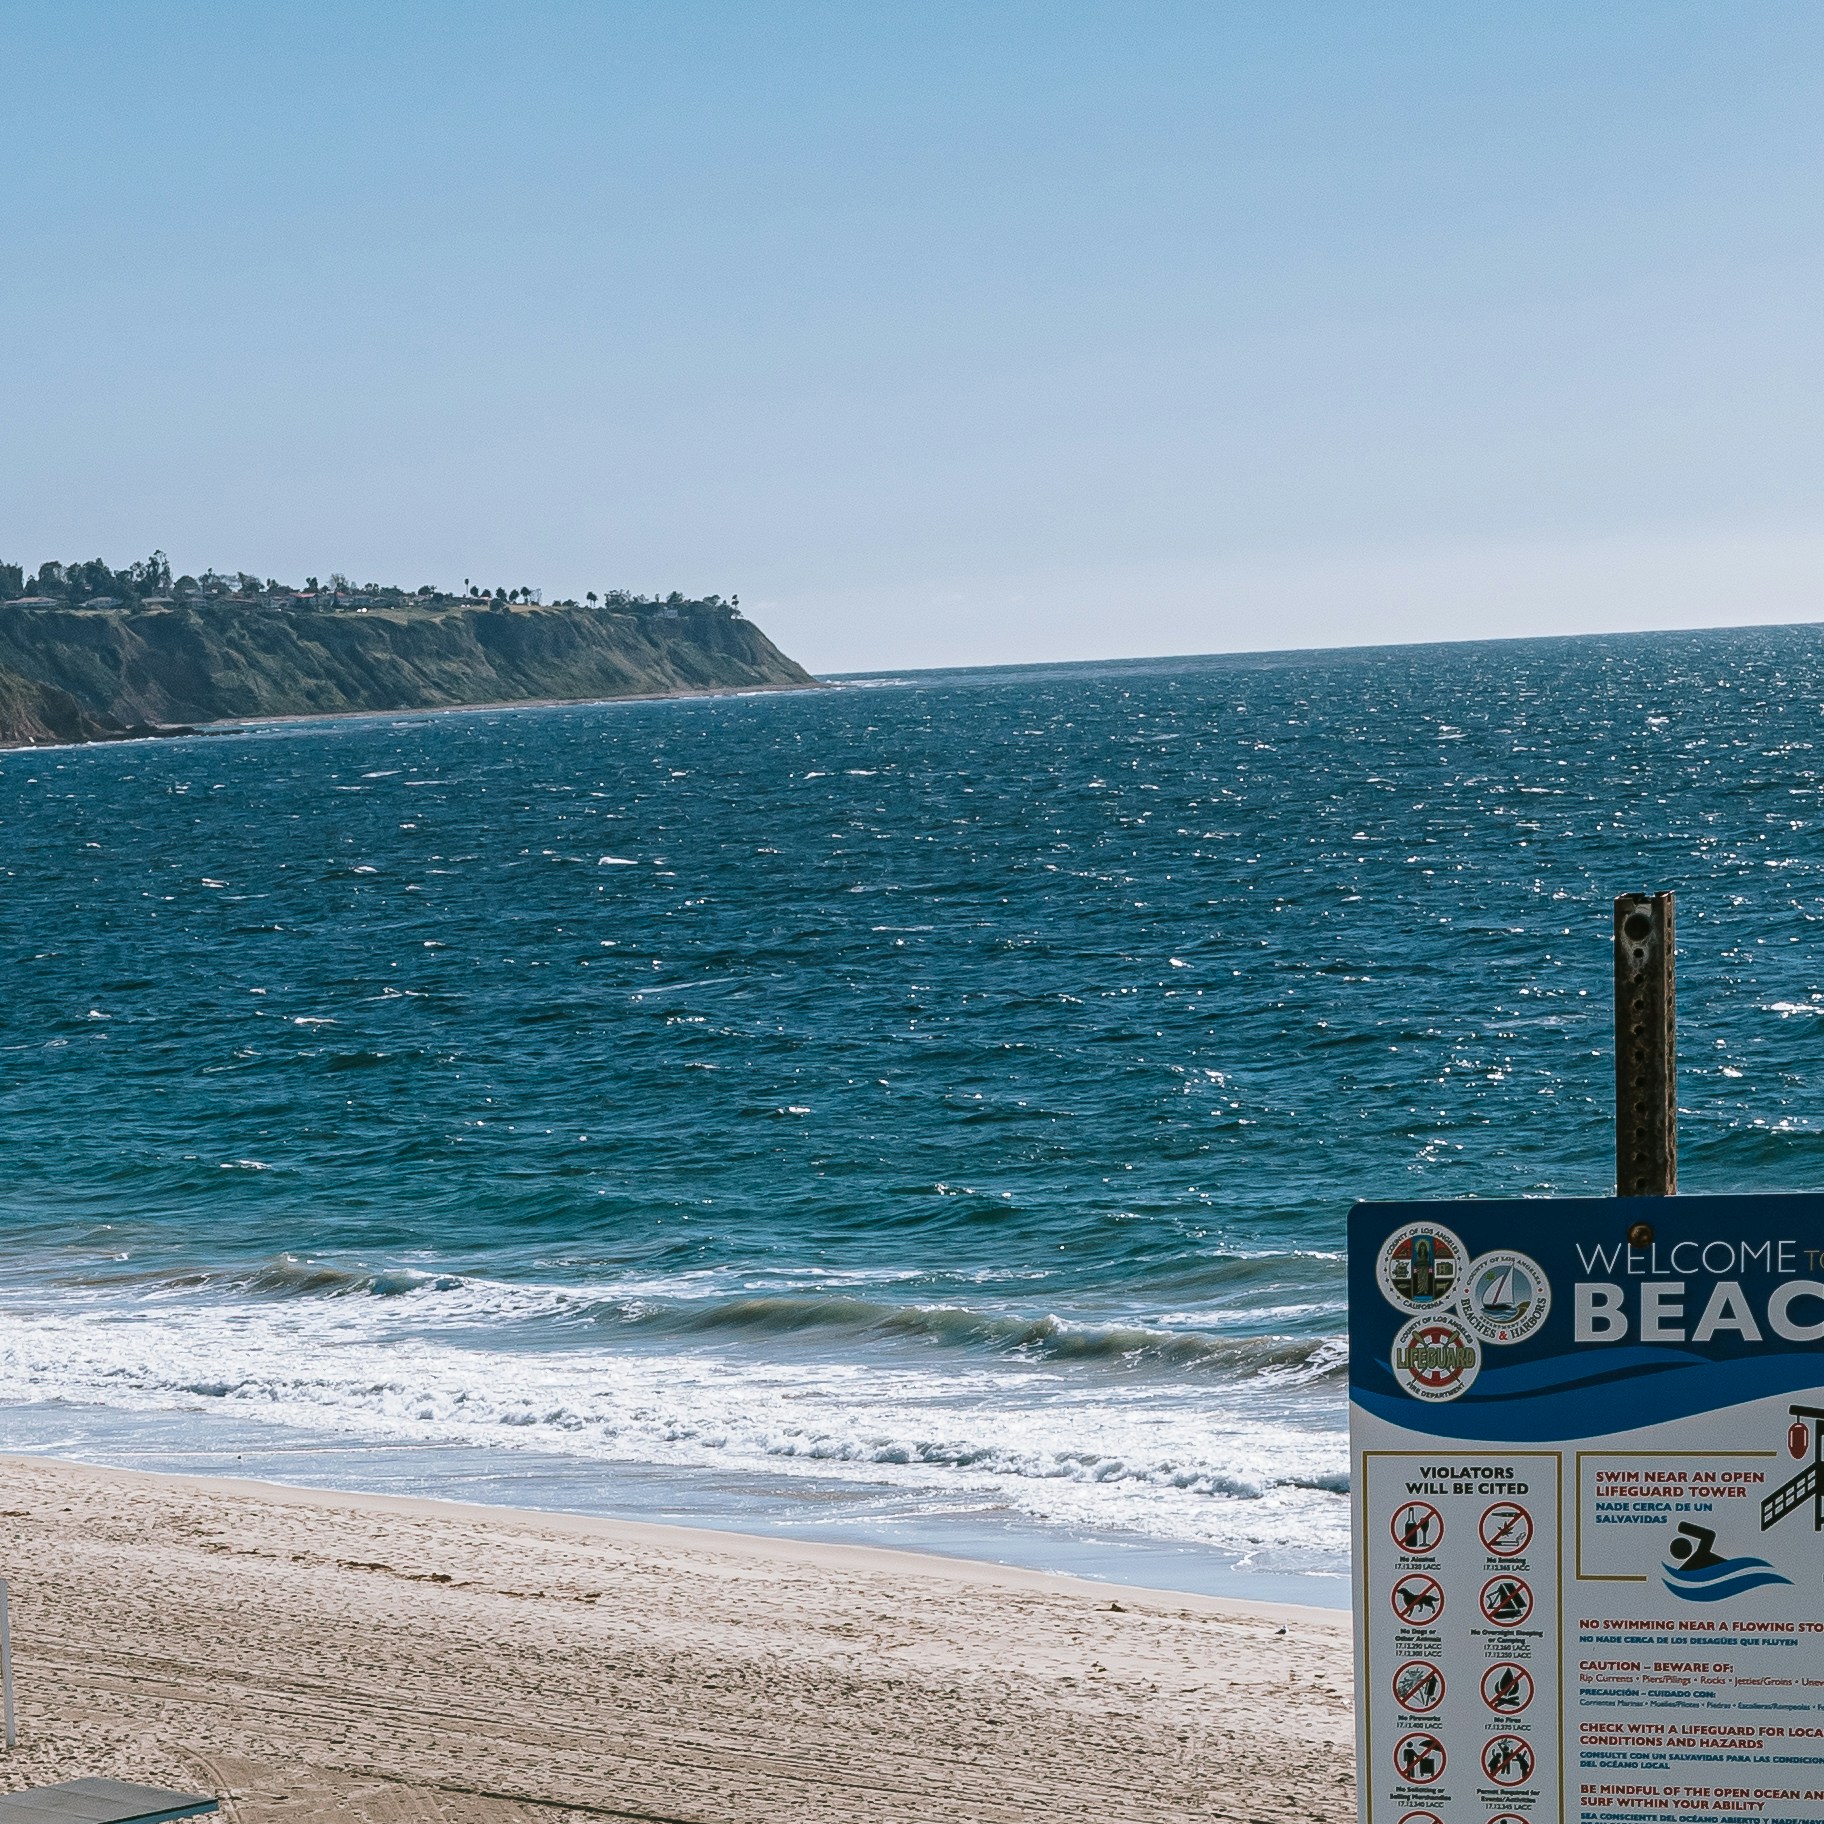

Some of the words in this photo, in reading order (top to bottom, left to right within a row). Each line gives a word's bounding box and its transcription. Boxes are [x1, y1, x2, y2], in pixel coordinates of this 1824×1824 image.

[1387, 1232, 1407, 1255] COUNTY
[1409, 1228, 1418, 1236] OF
[1435, 1231, 1460, 1255] ANGELES
[1576, 1240, 1797, 1275] WELCOME
[1803, 1250, 1824, 1272] T
[1403, 1300, 1444, 1310] CALIFORNIA
[1574, 1280, 1824, 1342] BEAC
[1461, 1298, 1497, 1339] BEACHES
[1498, 1330, 1509, 1340] &
[1510, 1297, 1547, 1339] HARBORS
[1400, 1320, 1421, 1343] COUNTY
[1396, 1347, 1476, 1369] LIFEGUARD
[1419, 1466, 1514, 1479] VIOLATORS
[1596, 1471, 1639, 1483] SWIM
[1644, 1472, 1688, 1483] NEAR
[1692, 1472, 1716, 1483] AN
[1720, 1472, 1765, 1483] OPEN
[1405, 1482, 1448, 1495] WILL
[1453, 1483, 1474, 1495] BE
[1477, 1483, 1529, 1495] CITED
[1596, 1486, 1684, 1497] LIFEGUARD
[1688, 1486, 1747, 1498] TOWER
[1595, 1503, 1629, 1512] NADE
[1632, 1503, 1672, 1512] CERCA
[1675, 1503, 1691, 1512] DE
[1694, 1503, 1713, 1512] UN
[1595, 1515, 1668, 1524] SALVAVIDAS
[1579, 1619, 1600, 1629] NO
[1603, 1620, 1675, 1630] SWIMMING
[1678, 1621, 1715, 1631] NEAR
[1719, 1622, 1728, 1631] A
[1732, 1622, 1795, 1632] FLOWING
[1596, 1636, 1622, 1644] NADE
[1624, 1636, 1654, 1644] CERCA
[1690, 1636, 1737, 1645] DESAGÜES
[1740, 1638, 1760, 1646] QUE
[1579, 1661, 1641, 1671] CAUTION
[1653, 1662, 1709, 1672] BEWARE
[1713, 1663, 1734, 1673] OF:
[1579, 1673, 1593, 1683] Rip
[1596, 1674, 1633, 1683] Currents
[1700, 1676, 1726, 1685] Rocks
[1579, 1688, 1640, 1696] PRECAUCIÓN
[1579, 1722, 1624, 1733] CHECK
[1627, 1724, 1664, 1734] WITH
[1668, 1724, 1678, 1734] A
[1681, 1725, 1756, 1736] LIFEGUARD
[1759, 1727, 1785, 1737] FOR
[1788, 1727, 1824, 1738] LOCA
[1579, 1735, 1663, 1746] CONDITIONS
[1666, 1737, 1697, 1747] AND
[1699, 1738, 1764, 1749] HAZARDS
[1579, 1751, 1628, 1759] CONSULTE
[1630, 1752, 1650, 1760] CON
[1668, 1753, 1724, 1761] SALVAVIDAS
[1753, 1755, 1771, 1763] LAS
[1580, 1760, 1597, 1768] DEL
[1599, 1760, 1638, 1769] OCÉANO
[1580, 1784, 1597, 1794] BE
[1600, 1785, 1660, 1796] MINDFUL
[1663, 1786, 1681, 1796] OF
[1684, 1787, 1710, 1797] THE
[1714, 1788, 1750, 1798] OPEN
[1754, 1789, 1801, 1800] OCEAN
[1580, 1797, 1614, 1807] SURF
[1617, 1797, 1669, 1808] WITHIN
[1672, 1799, 1709, 1809] YOUR
[1712, 1801, 1766, 1811] ABILITY
[1599, 1813, 1658, 1822] CONSCIENTE
[1678, 1814, 1718, 1823] OCÉANO
[1720, 1816, 1761, 1824] ABIERTO
